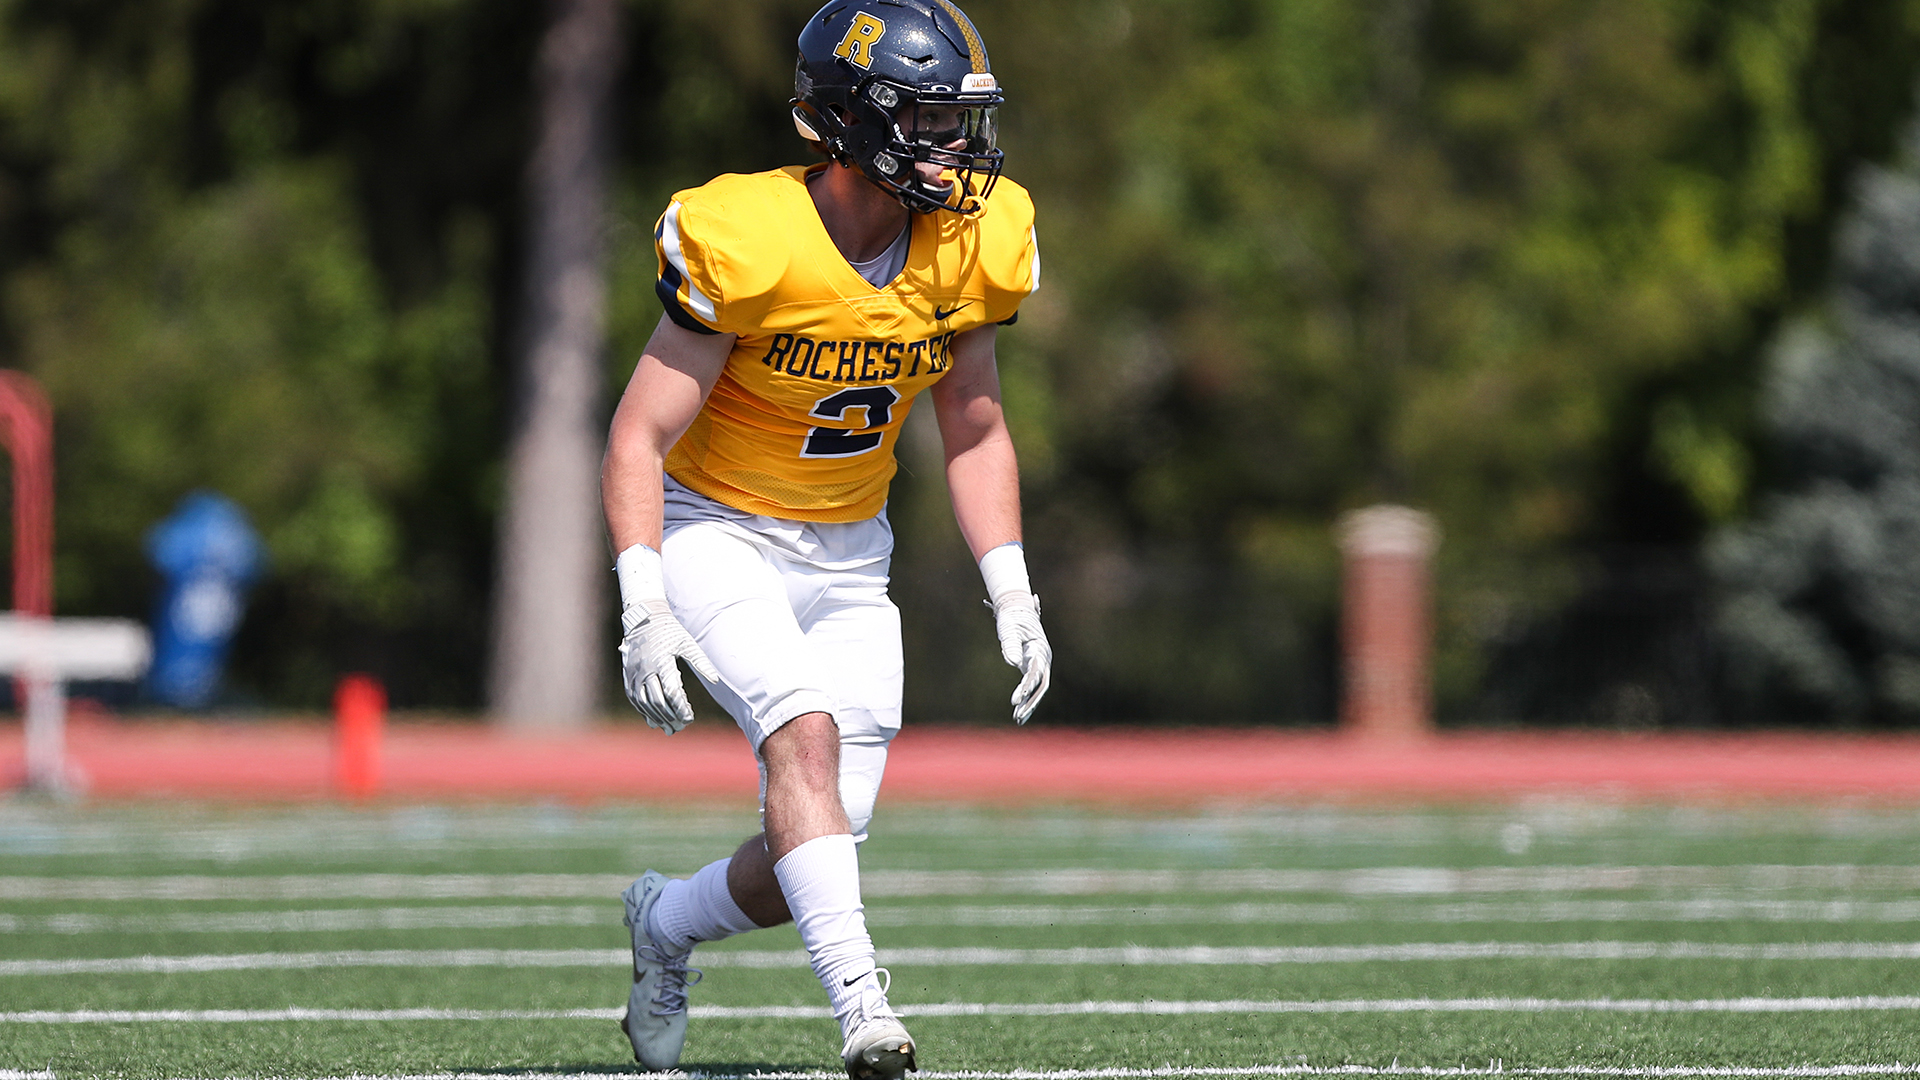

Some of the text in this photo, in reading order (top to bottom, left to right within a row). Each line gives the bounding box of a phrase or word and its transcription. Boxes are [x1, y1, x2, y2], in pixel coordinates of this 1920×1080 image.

[833, 10, 886, 71] R
[762, 330, 957, 382] ROCHESTER
[799, 385, 902, 459] 2
